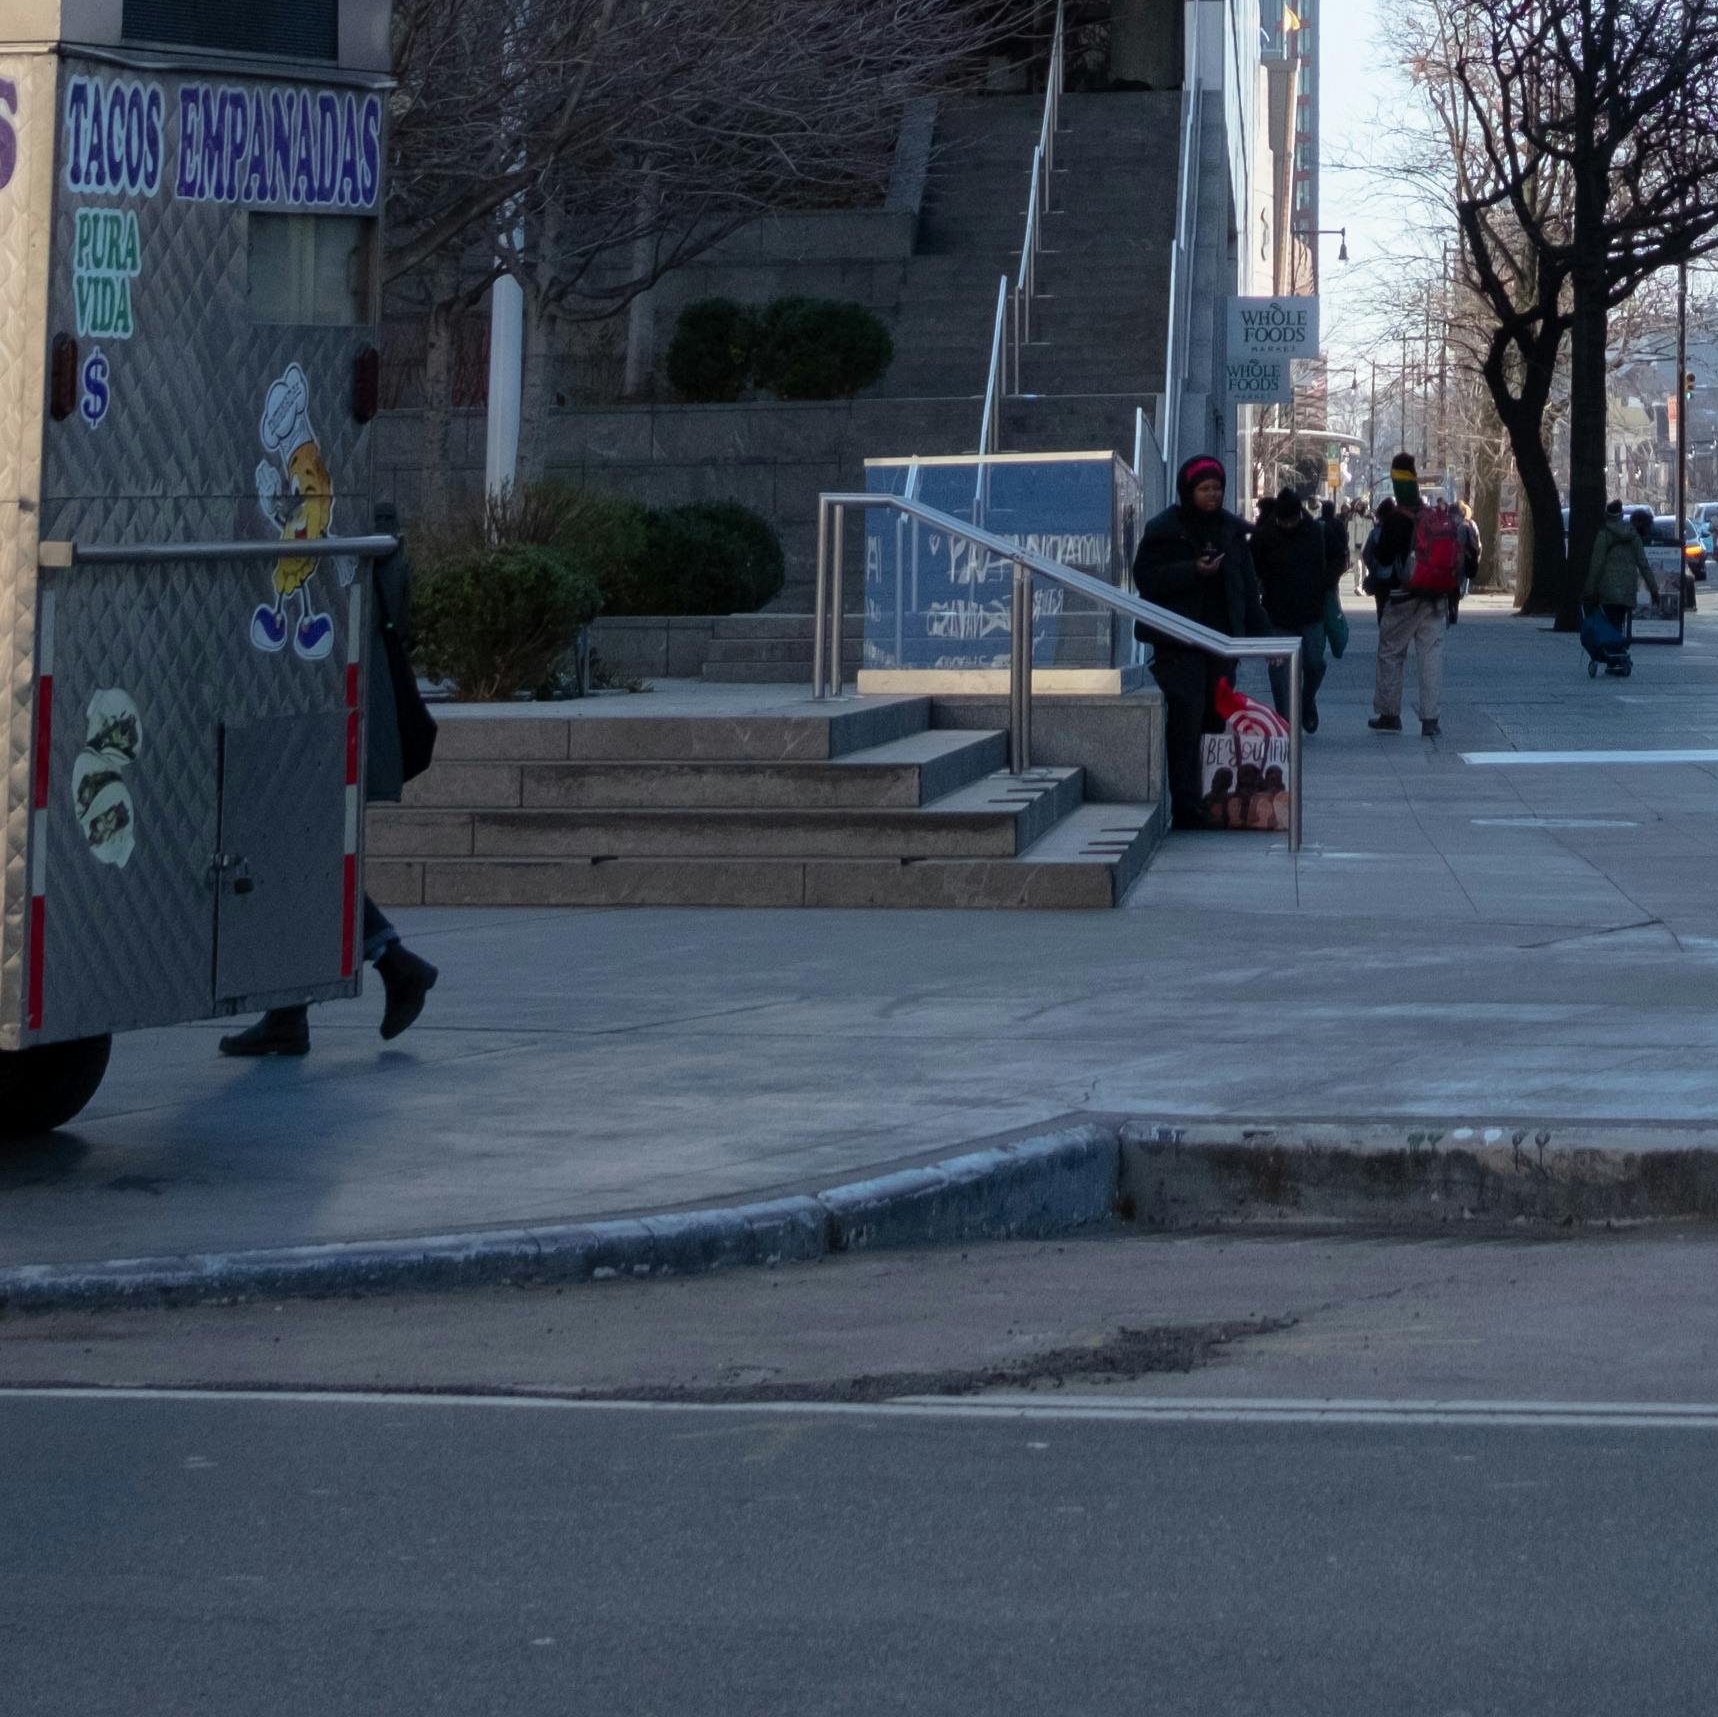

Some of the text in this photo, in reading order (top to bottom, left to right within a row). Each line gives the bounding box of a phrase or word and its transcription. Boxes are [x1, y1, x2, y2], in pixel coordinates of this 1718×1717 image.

[69, 79, 163, 193] TACOS
[176, 84, 382, 206] EMPANADAS
[76, 210, 139, 273] PURA
[75, 274, 132, 336] VIDA
[1241, 309, 1308, 326] WHOLE
[1244, 327, 1306, 343] FOODS
[83, 349, 109, 426] $
[1226, 364, 1281, 378] WHOLE
[1228, 379, 1279, 391] FOODS
